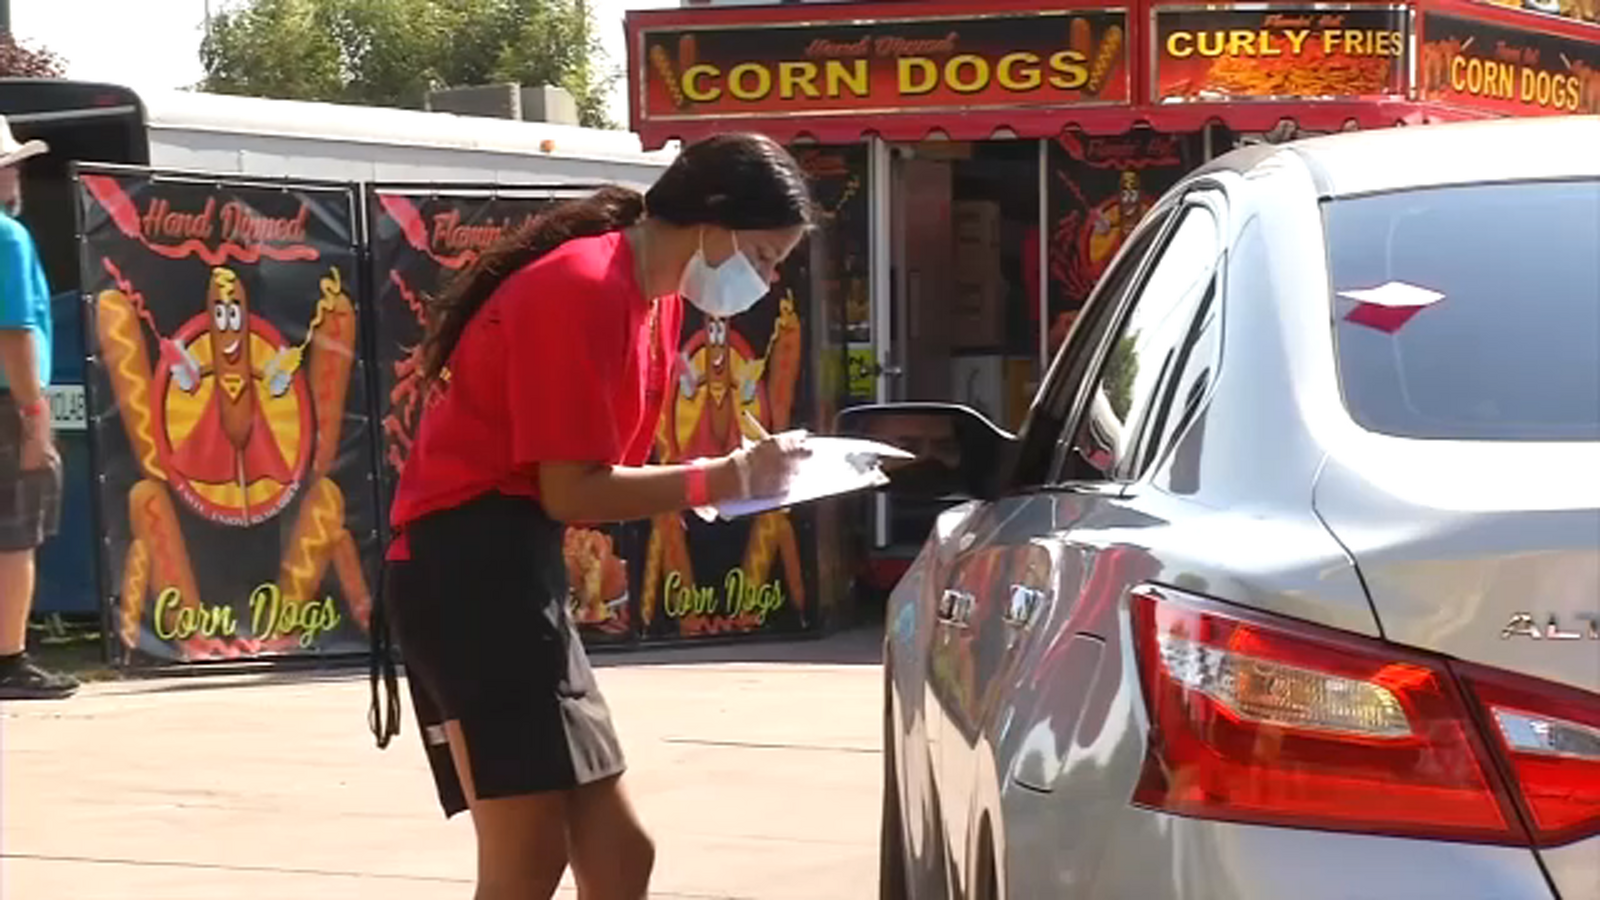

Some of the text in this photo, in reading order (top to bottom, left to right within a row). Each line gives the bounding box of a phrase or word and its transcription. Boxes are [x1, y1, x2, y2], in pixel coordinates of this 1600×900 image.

[1166, 30, 1403, 57] CURLY FRIES
[681, 50, 1090, 102] CORN DOGS
[1451, 55, 1580, 111] CORN DOGS
[141, 196, 215, 238] Hand
[154, 583, 341, 647] Corn Dogs
[664, 568, 785, 625] Corn Dogs
